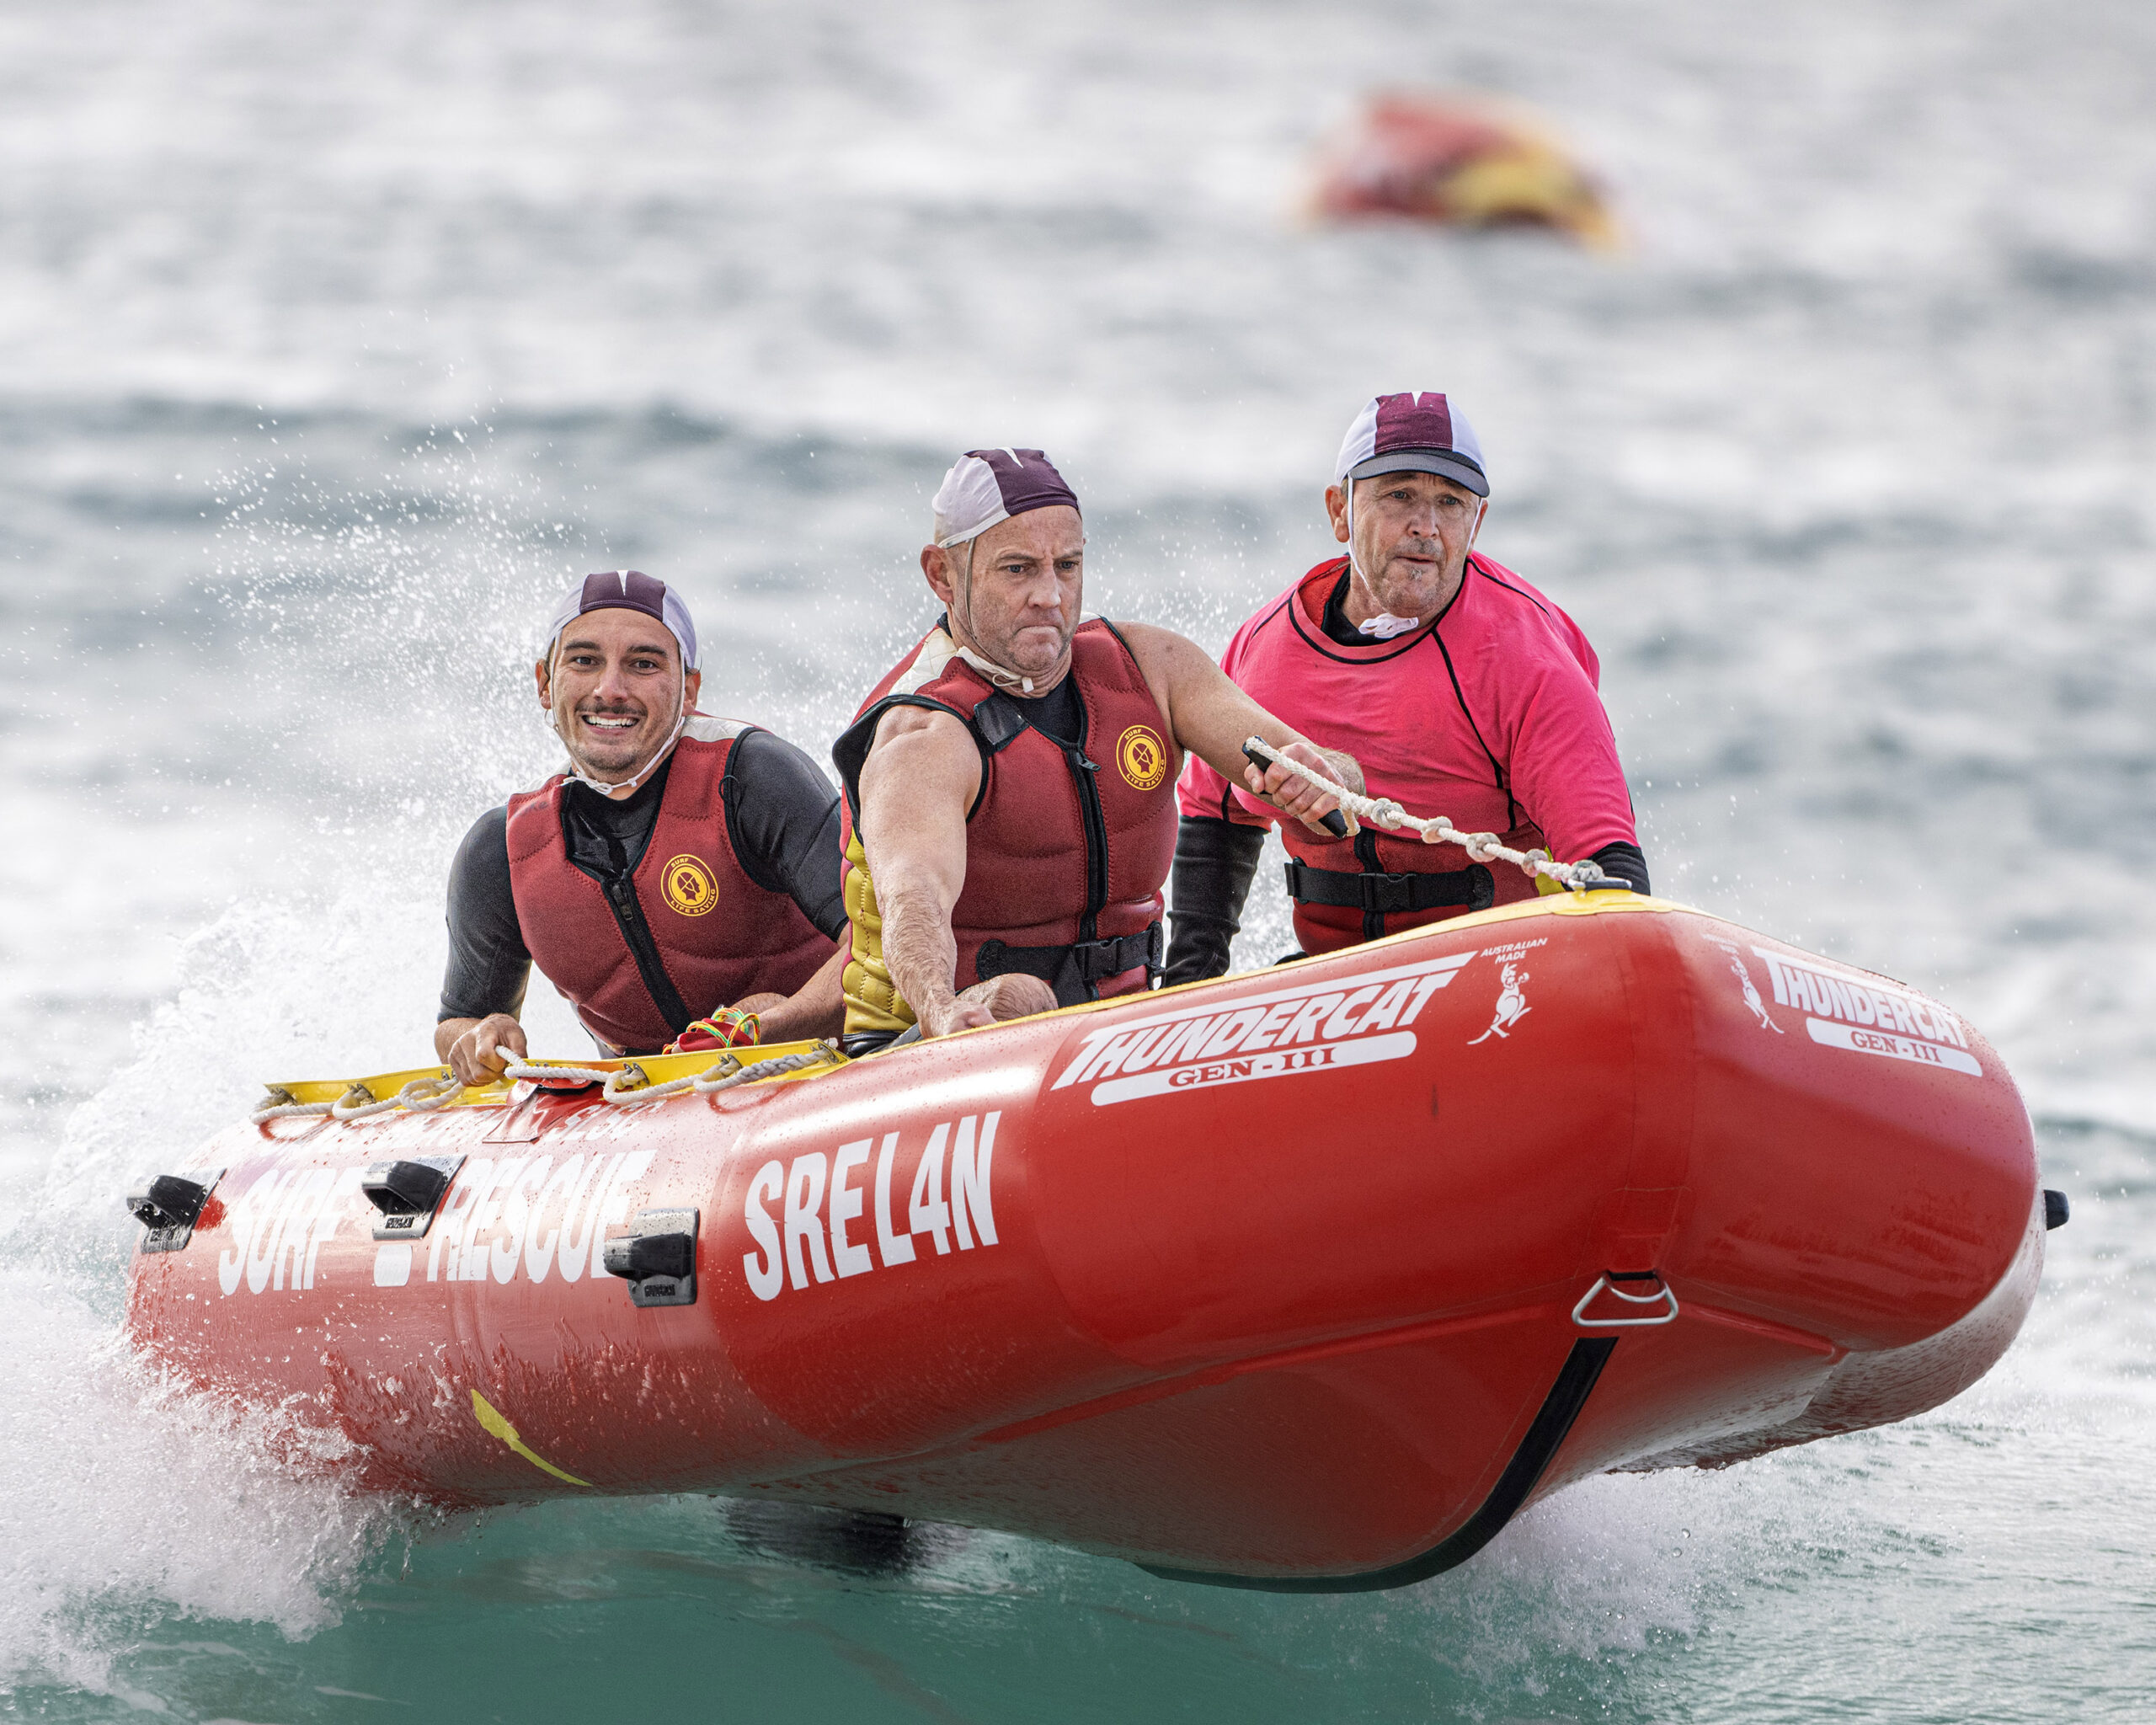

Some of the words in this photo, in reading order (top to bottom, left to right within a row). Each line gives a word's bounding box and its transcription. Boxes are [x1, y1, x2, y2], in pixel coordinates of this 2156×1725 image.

[1124, 728, 1142, 740] SURF
[1126, 773, 1144, 787] LIFE
[1146, 759, 1165, 787] SAVING
[670, 857, 690, 868] SURF
[670, 900, 691, 913] LIFE
[693, 889, 716, 913] SAVING
[1480, 937, 1548, 958] AUSTRALIAN
[1494, 949, 1527, 964] MADE
[1750, 945, 1968, 1049] THUNDERCAT
[1051, 951, 1478, 1091] THUNDERCAT
[743, 1110, 1001, 1301] SREL4N
[218, 1166, 371, 1295] SURF
[426, 1149, 658, 1284] RESCUE
